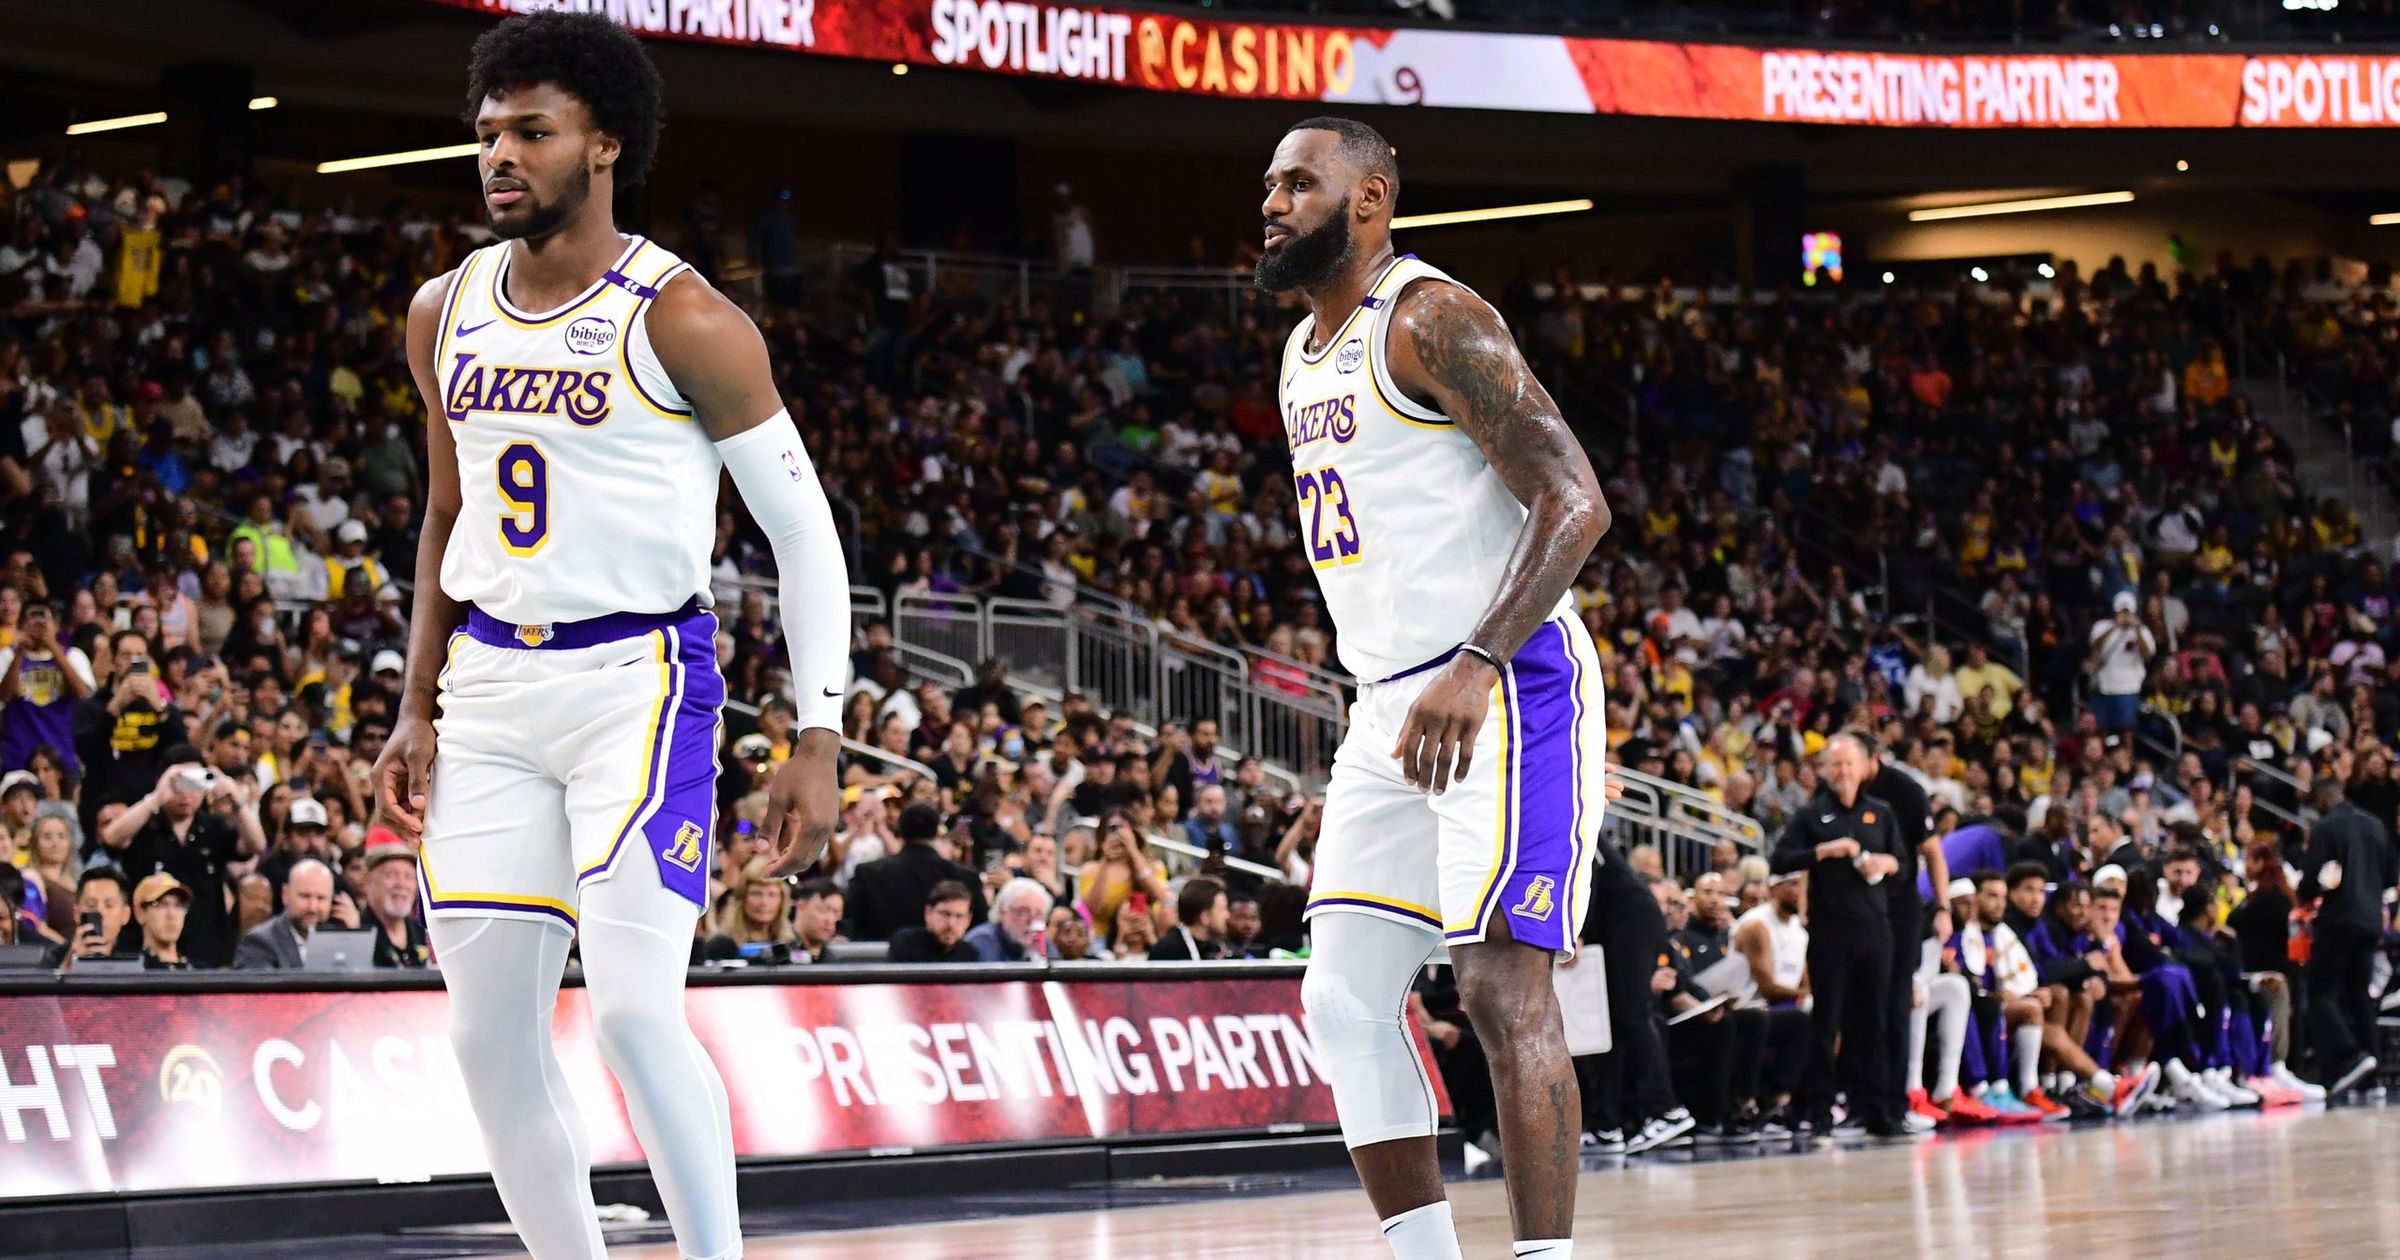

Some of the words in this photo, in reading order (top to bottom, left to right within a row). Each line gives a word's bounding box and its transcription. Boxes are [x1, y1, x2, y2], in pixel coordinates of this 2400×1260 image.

[931, 0, 1132, 81] SPOTLIGHT
[1171, 21, 1355, 95] CASINO
[1761, 52, 1961, 122] PRESENTING
[1963, 58, 2120, 122] PARTNER
[570, 326, 614, 345] bibigo
[445, 351, 614, 428] LAKERS
[497, 441, 549, 558] 9
[1294, 464, 1363, 570] 23
[784, 1017, 1159, 1106] PRSENTING
